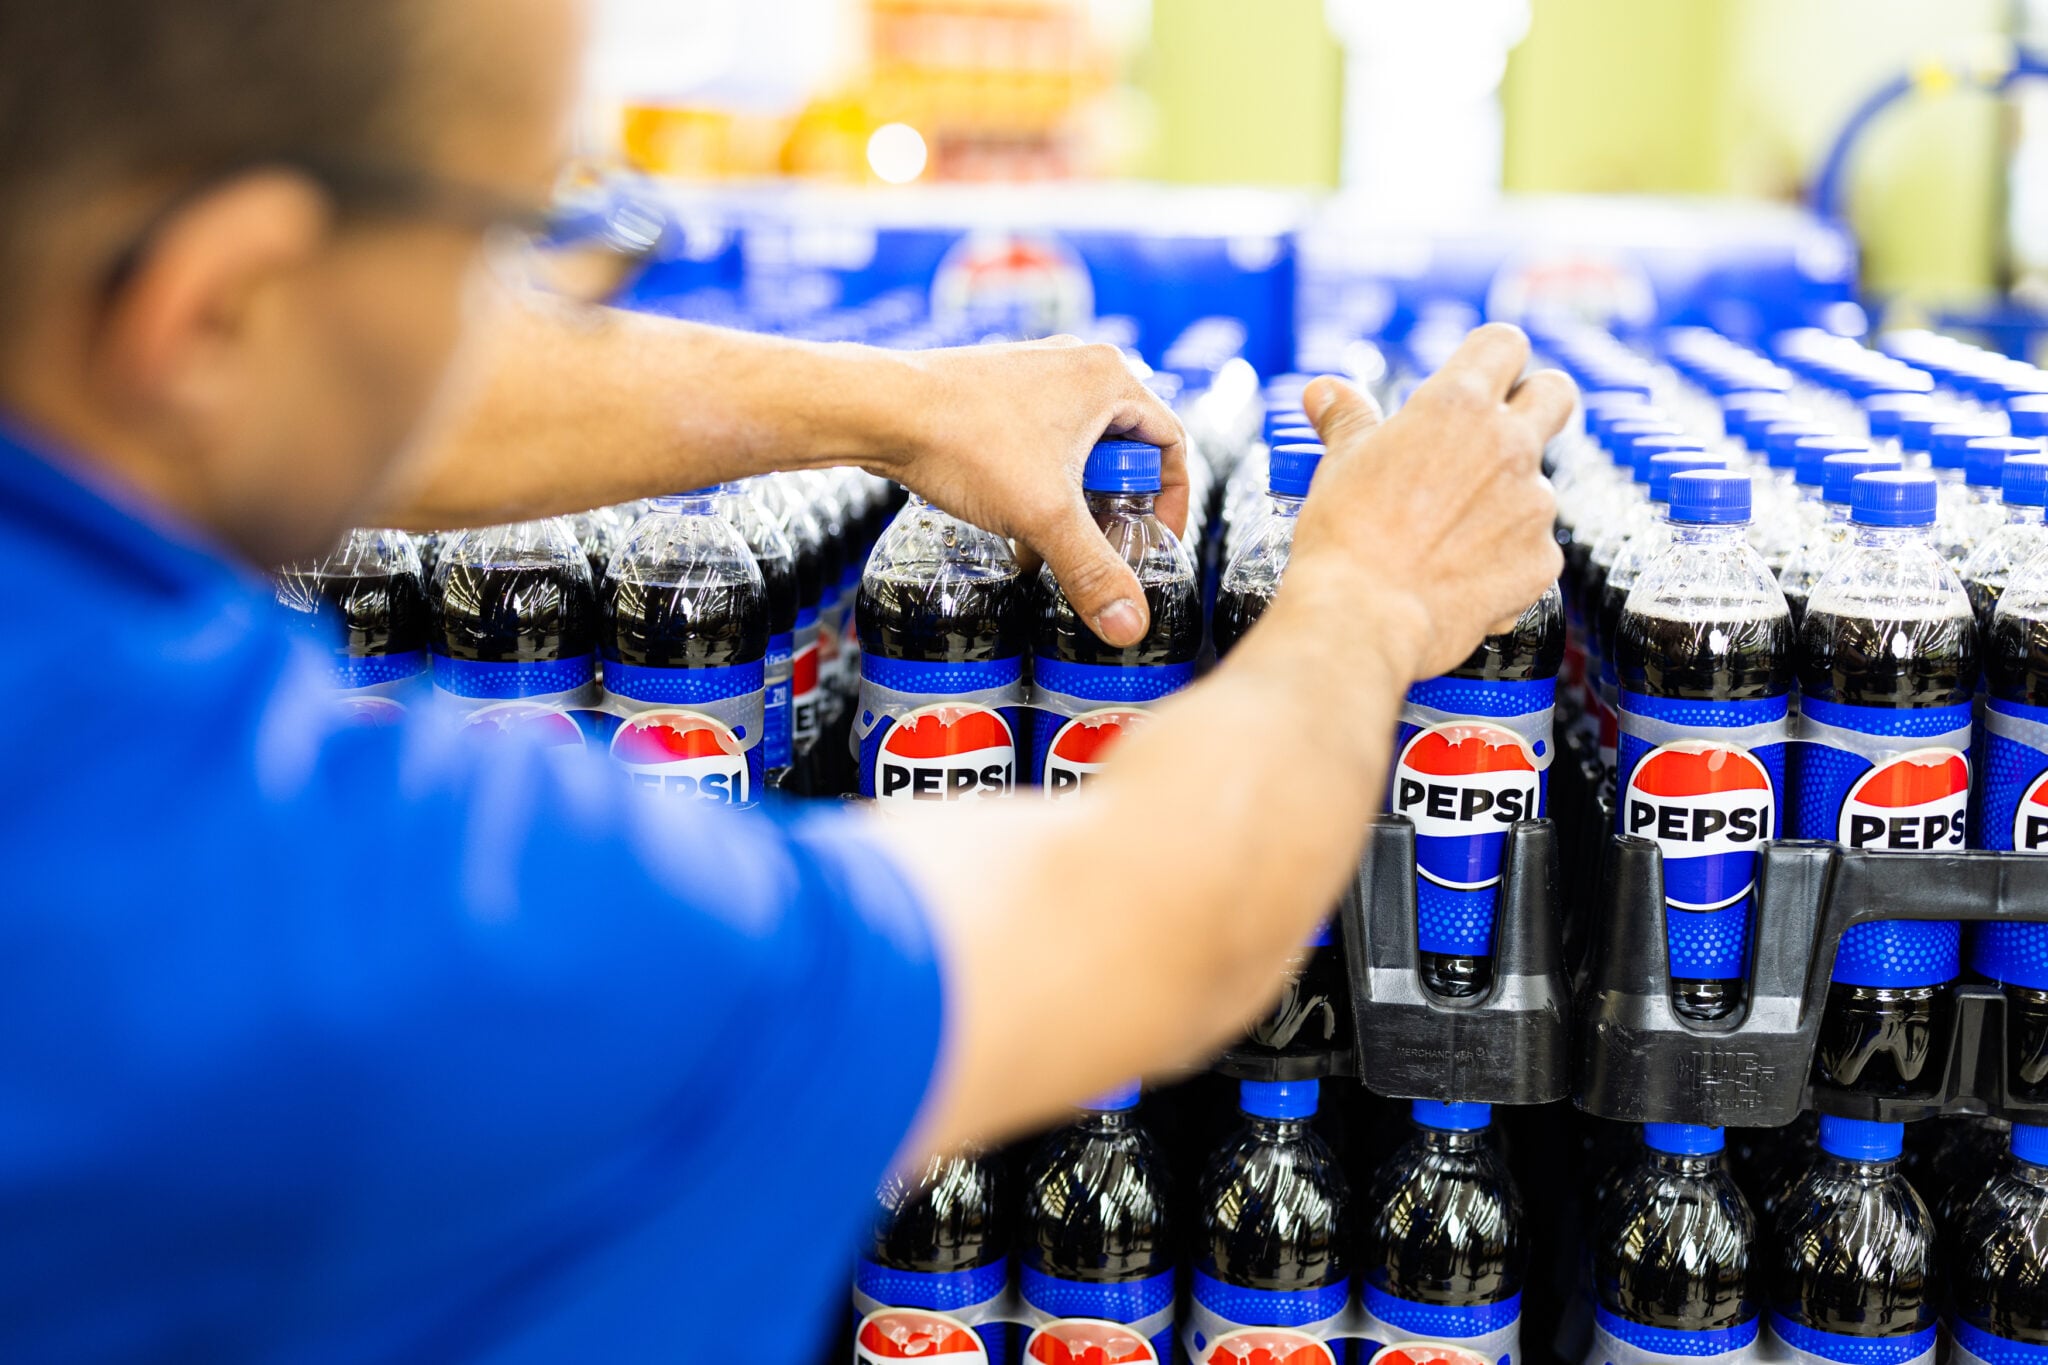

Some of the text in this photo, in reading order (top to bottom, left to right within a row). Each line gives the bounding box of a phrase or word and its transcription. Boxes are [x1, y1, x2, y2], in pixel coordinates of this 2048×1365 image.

[630, 769, 742, 805] EPSI
[883, 762, 1012, 802] PEPSI
[1399, 778, 1534, 822] PEPSI
[1630, 799, 1768, 843] PEPSI
[1850, 809, 1965, 850] PEPS
